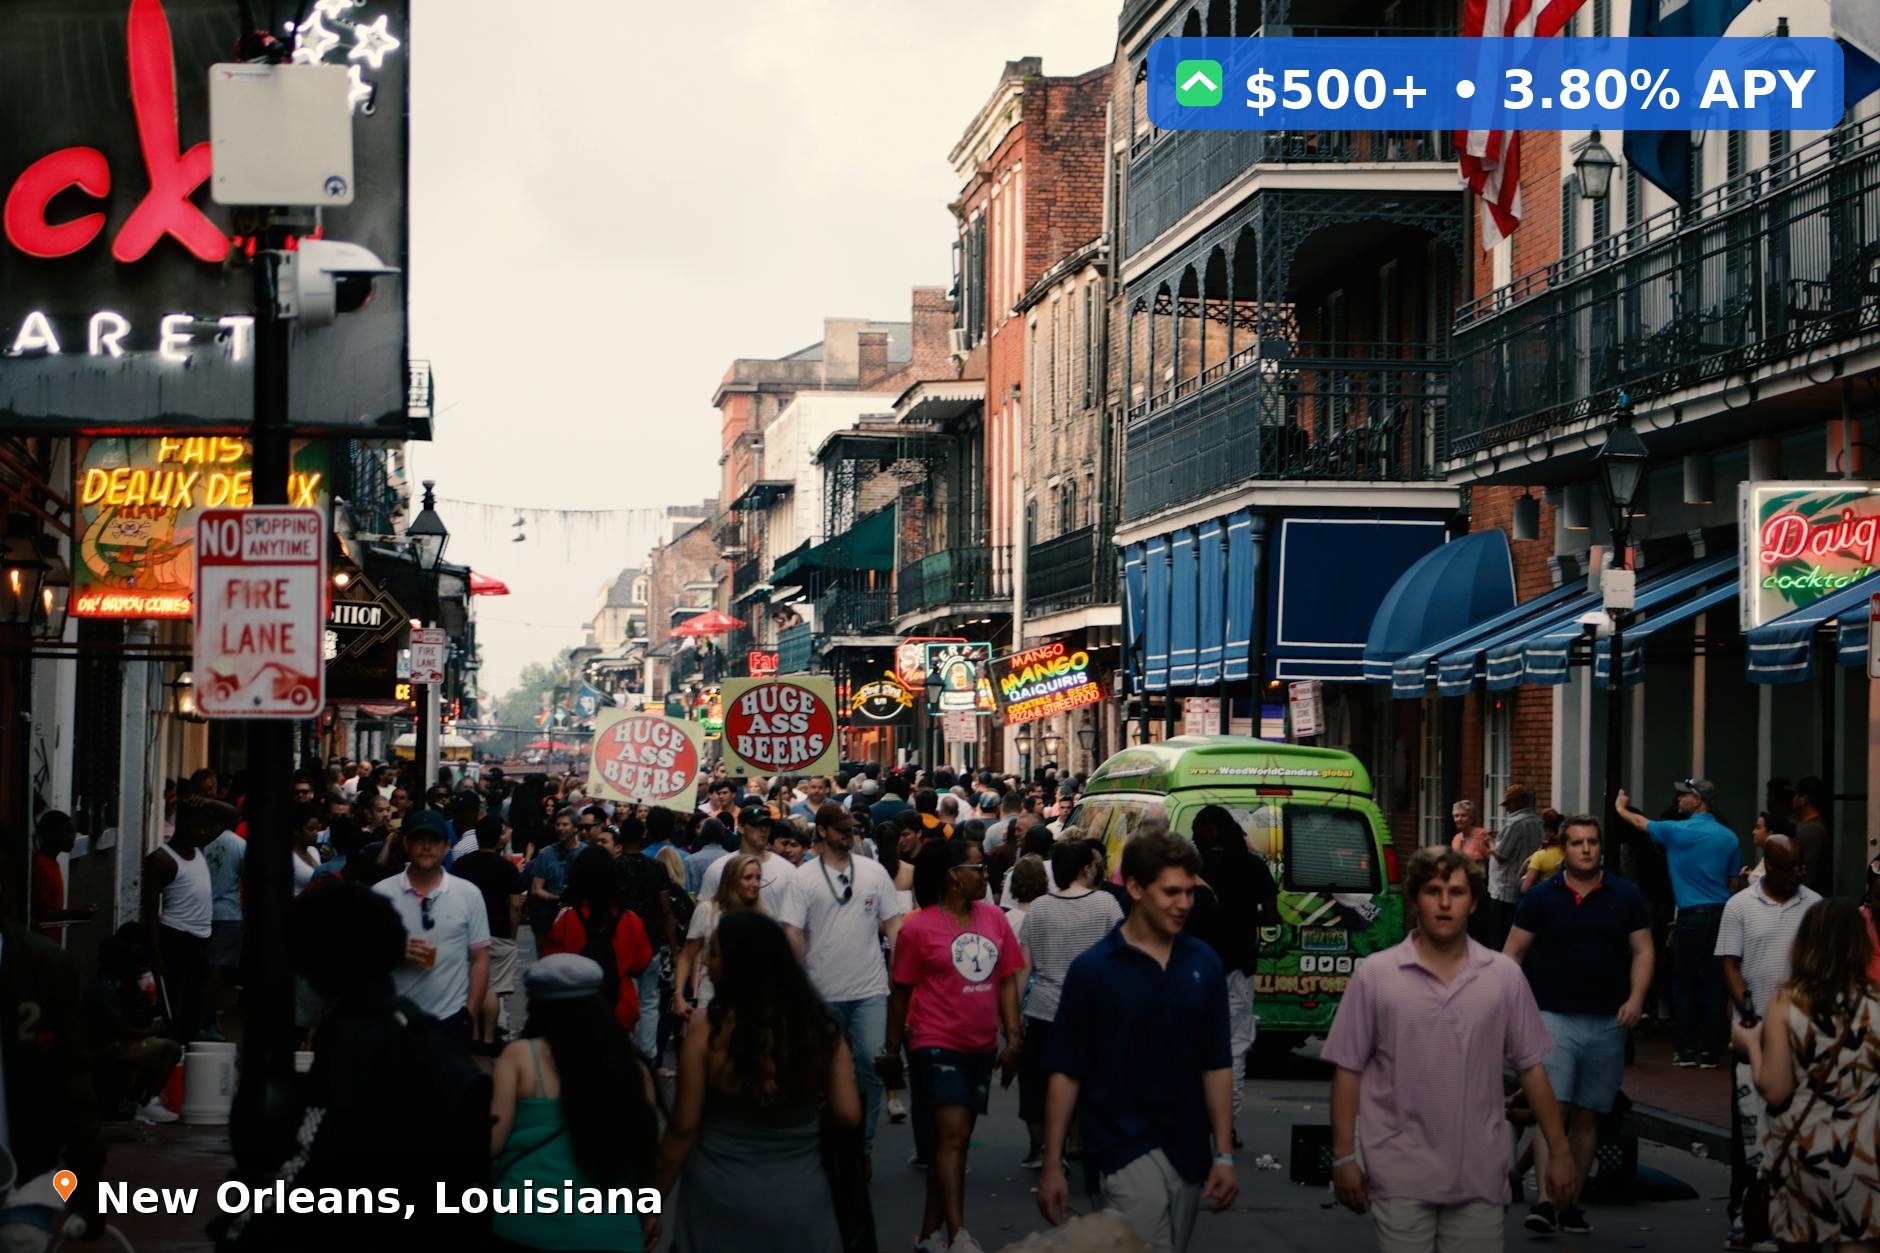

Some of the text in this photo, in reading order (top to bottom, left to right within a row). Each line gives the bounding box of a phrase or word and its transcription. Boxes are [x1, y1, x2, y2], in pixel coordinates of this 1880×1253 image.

[8, 311, 255, 362] ARET
[82, 467, 321, 508] DEAUX DEX
[201, 518, 319, 557] NO STOPPING
[248, 539, 312, 556] ANYTIME
[1760, 508, 1880, 565] Daiq
[101, 597, 144, 613] BAYOU
[145, 597, 191, 613] COMES
[227, 579, 291, 610] FIRE
[330, 604, 381, 625] ITION
[221, 623, 295, 654] LANE
[418, 647, 436, 656] FIRE
[417, 659, 436, 668] LANE
[1011, 643, 1064, 668] MANGO
[1001, 651, 1089, 695] MANGO
[1009, 672, 1088, 702] DAIQUIRIS
[742, 686, 817, 715] HUGE
[1067, 682, 1099, 698] BEER
[748, 713, 809, 734] ASS
[1009, 710, 1034, 724] PIZZA
[615, 718, 685, 752] HUGE
[737, 734, 824, 765] BEERS
[617, 744, 676, 768] ASS
[604, 759, 687, 796] BEERS
[1189, 767, 1354, 778] www.WeedWorldCandies.global
[17, 1000, 42, 1041] 2
